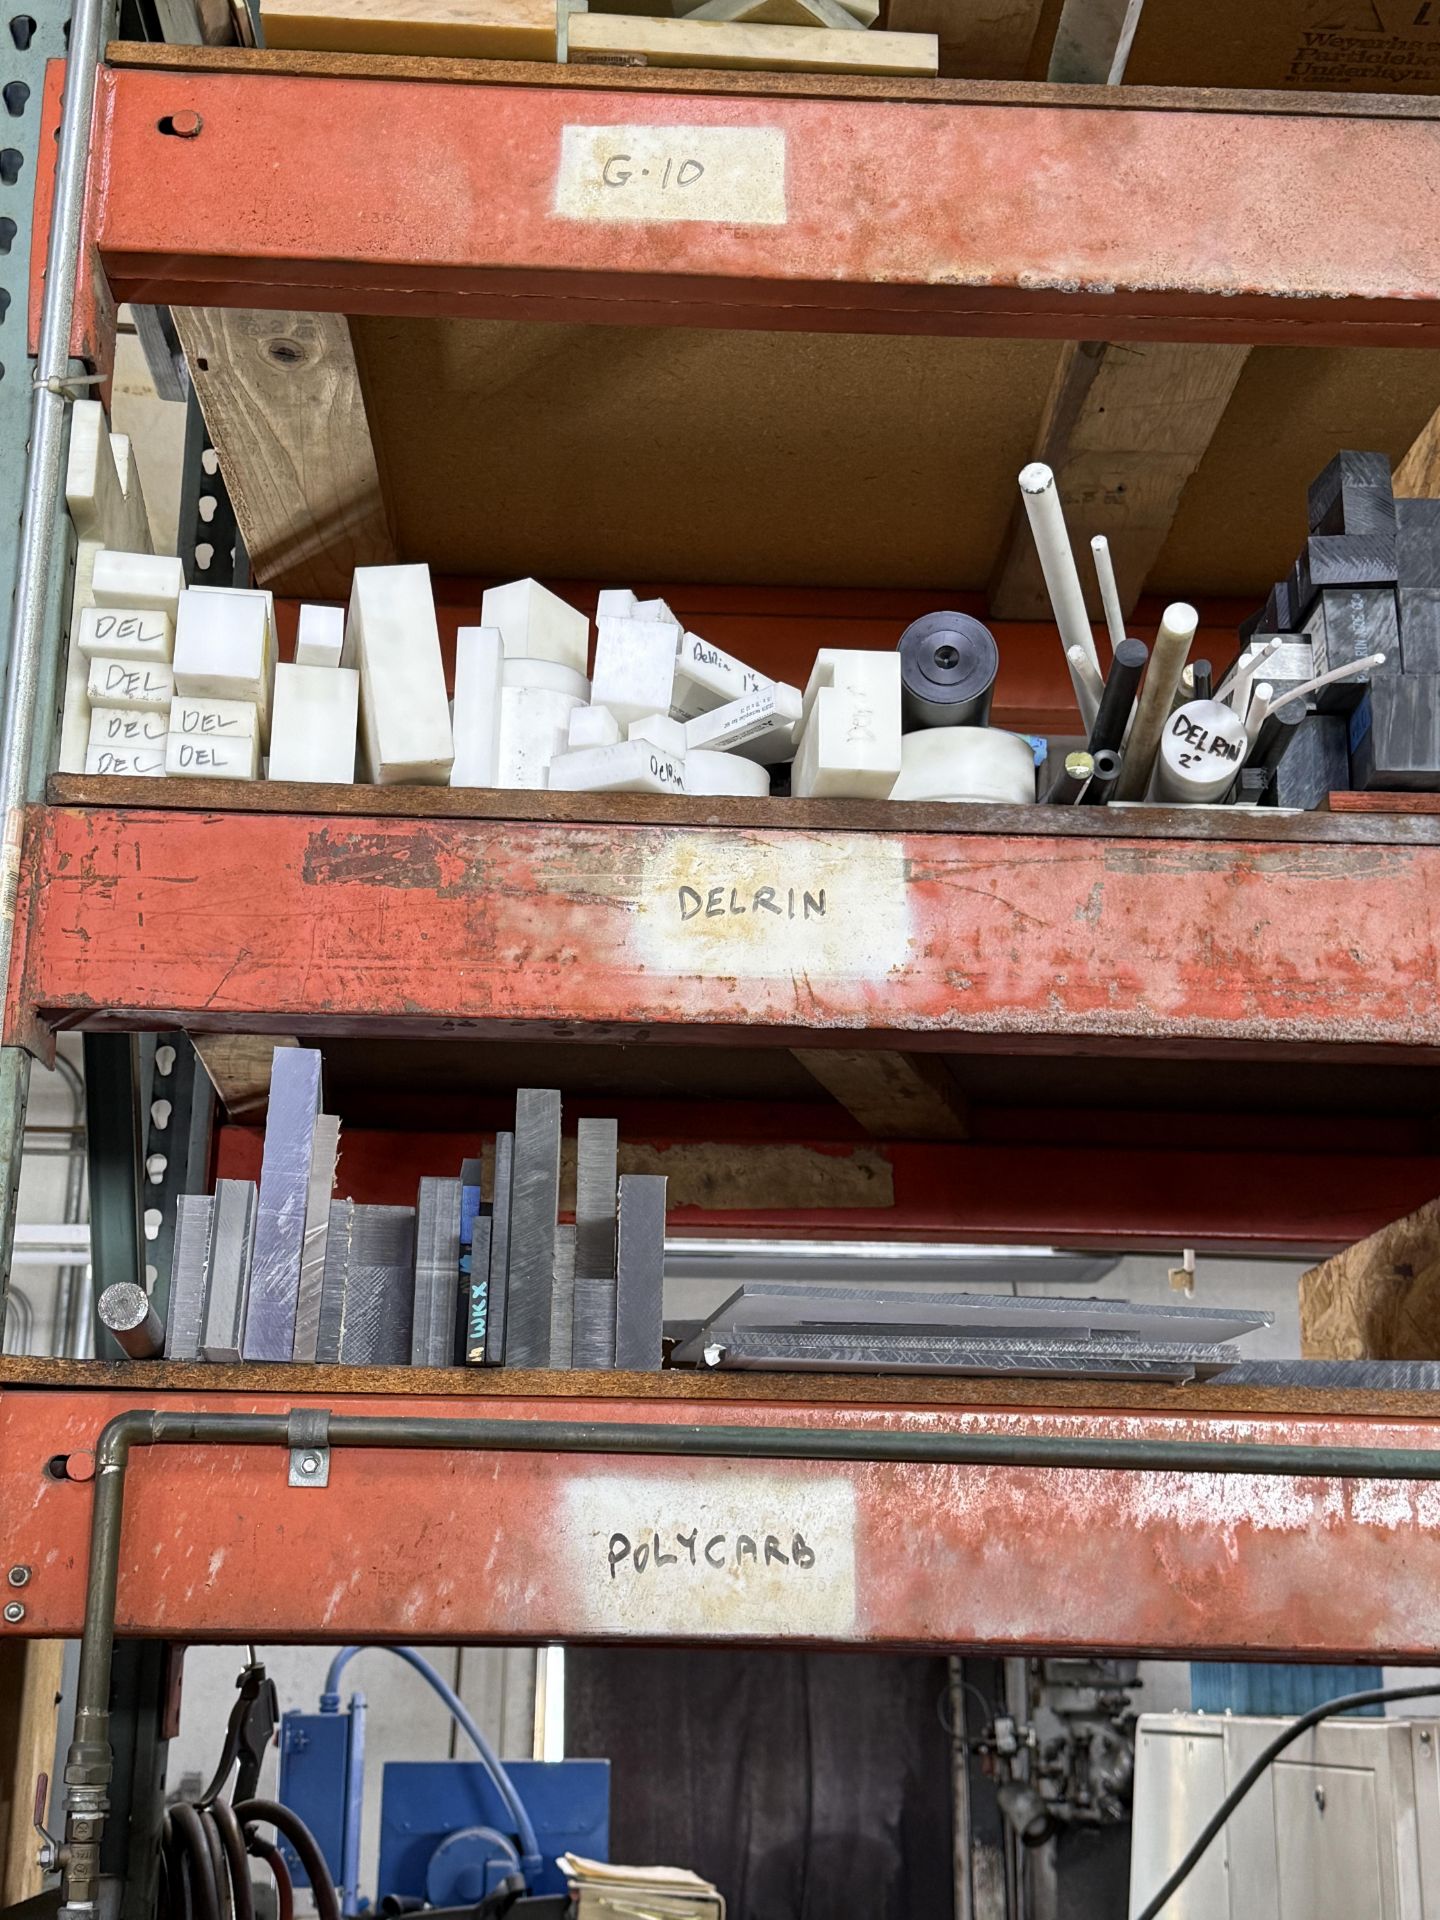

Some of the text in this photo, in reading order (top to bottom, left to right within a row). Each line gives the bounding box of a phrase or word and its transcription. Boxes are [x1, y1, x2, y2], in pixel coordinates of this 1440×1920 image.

[95, 615, 164, 642] DEL
[105, 664, 167, 695] DEL
[182, 710, 238, 733] DEL
[1171, 713, 1244, 763] DELRIN
[179, 744, 229, 767] DEL
[677, 884, 827, 922] DELRIN
[469, 1281, 488, 1339] WKX
[607, 1527, 816, 1579] POLYCARB
